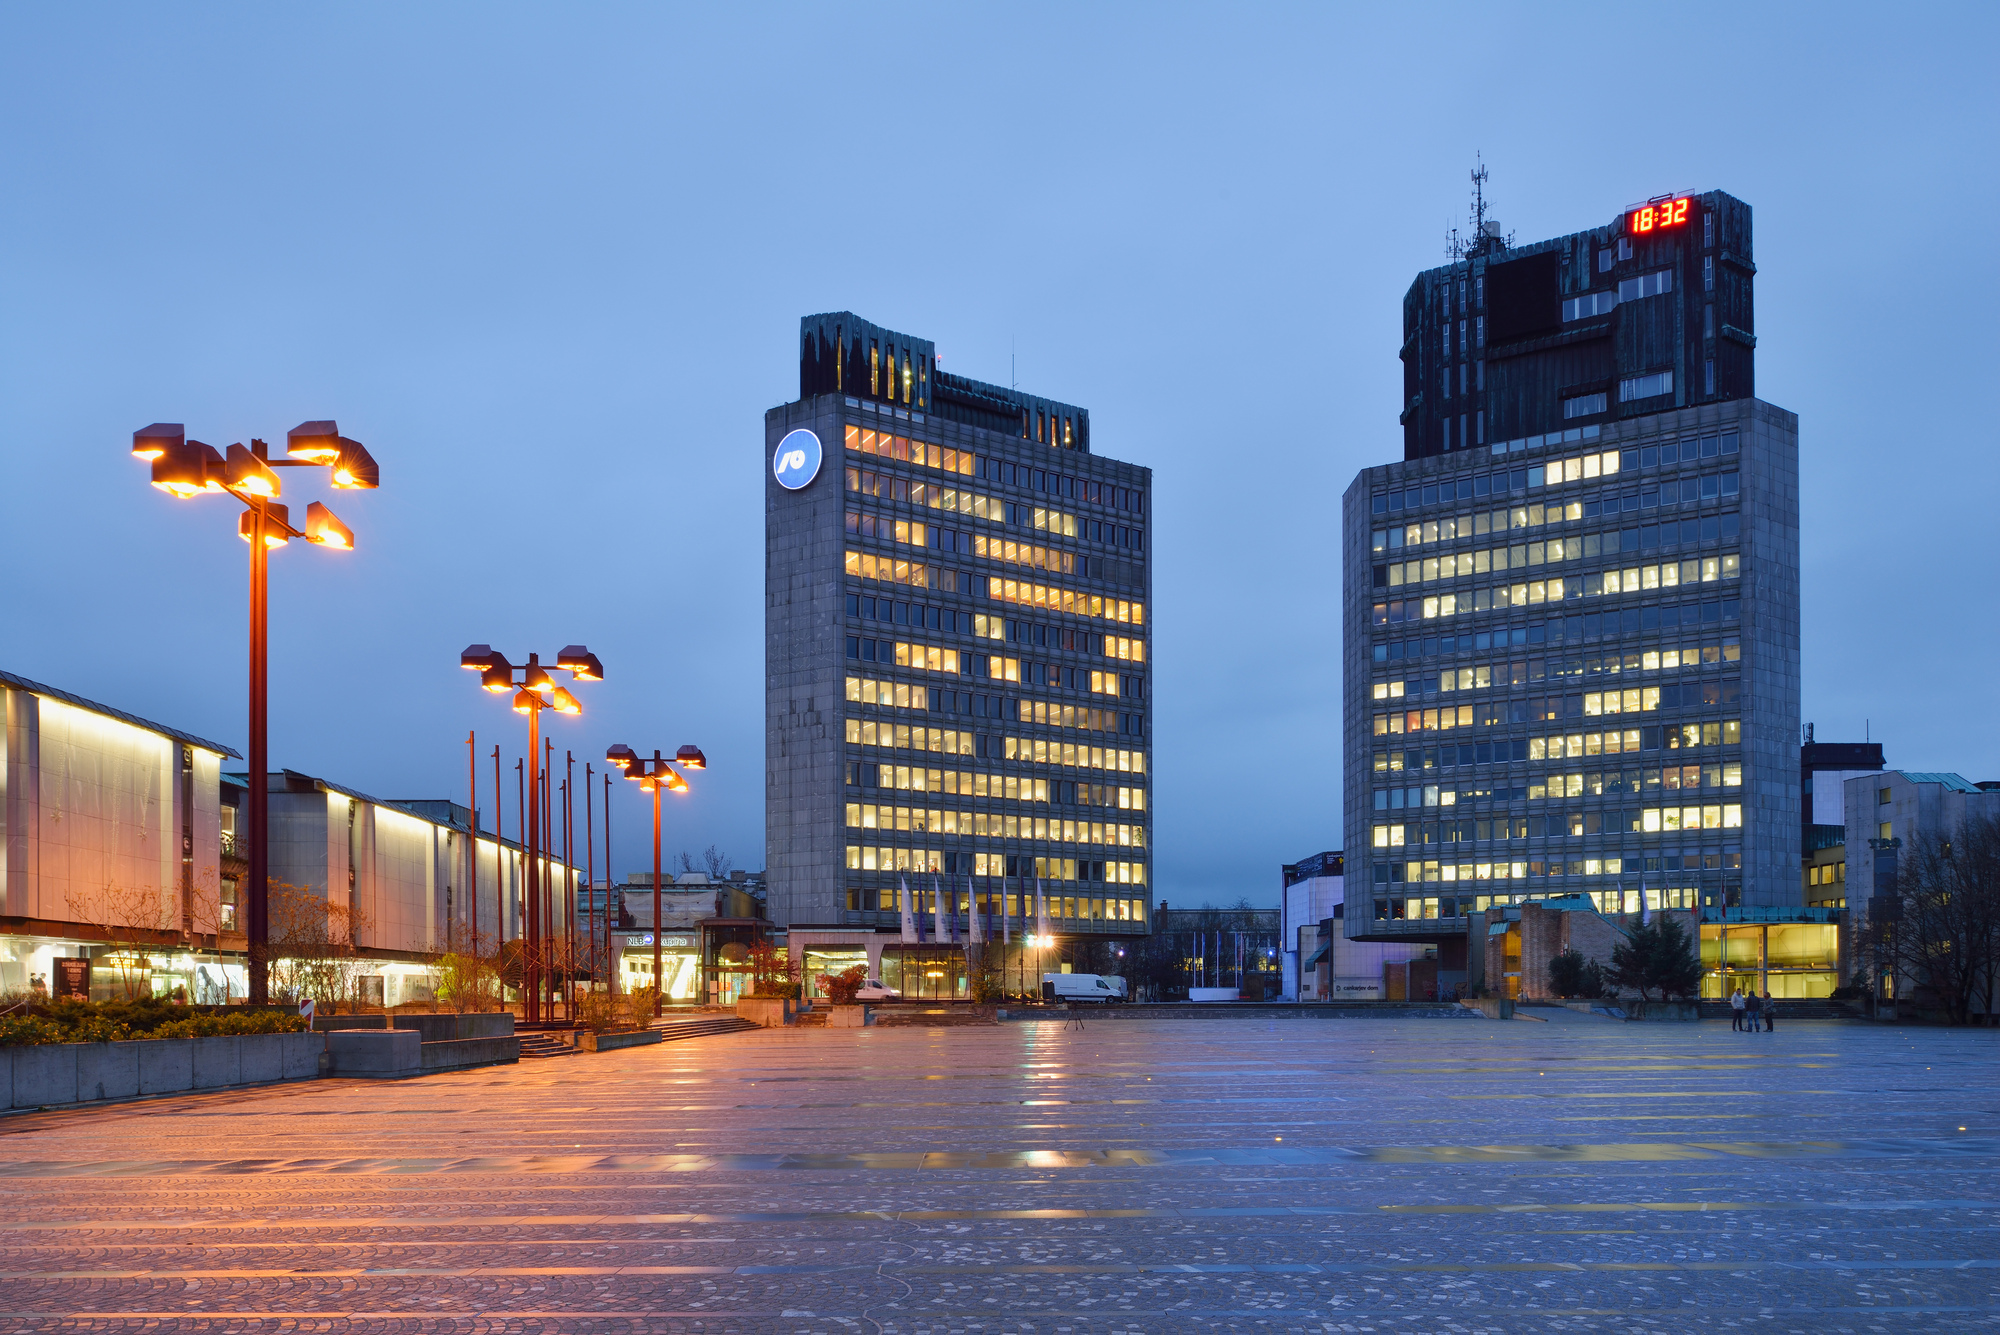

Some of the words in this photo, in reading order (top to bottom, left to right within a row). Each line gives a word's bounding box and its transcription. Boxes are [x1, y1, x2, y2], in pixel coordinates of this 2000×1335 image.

[1633, 198, 1688, 233] 18:32
[628, 937, 645, 945] NLB
[660, 936, 687, 946] kupina
